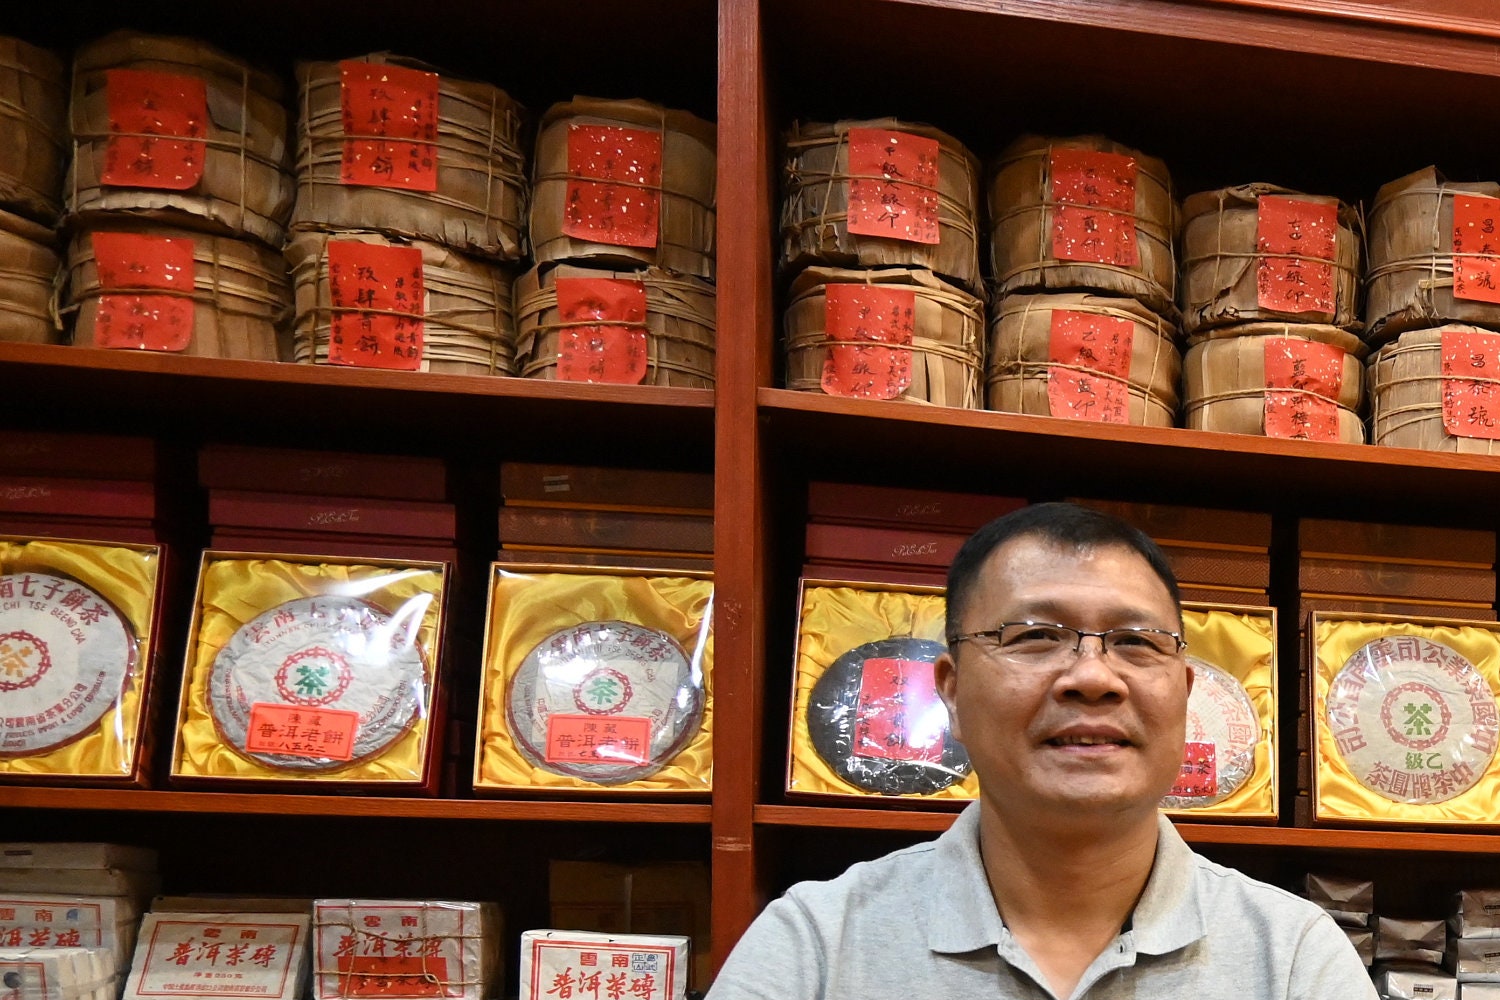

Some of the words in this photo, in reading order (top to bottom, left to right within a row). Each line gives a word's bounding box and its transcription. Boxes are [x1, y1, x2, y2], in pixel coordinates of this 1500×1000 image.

[294, 665, 330, 696] 茶
[585, 677, 619, 705] 茶
[1403, 702, 1434, 736] 茶
[257, 723, 344, 745] 普洱老餅
[203, 927, 257, 940] 雲南
[363, 915, 419, 927] 雲南
[165, 937, 278, 968] 普洱茶磚
[580, 952, 629, 967] 雲南
[546, 967, 658, 1000] 普洱茶磚
